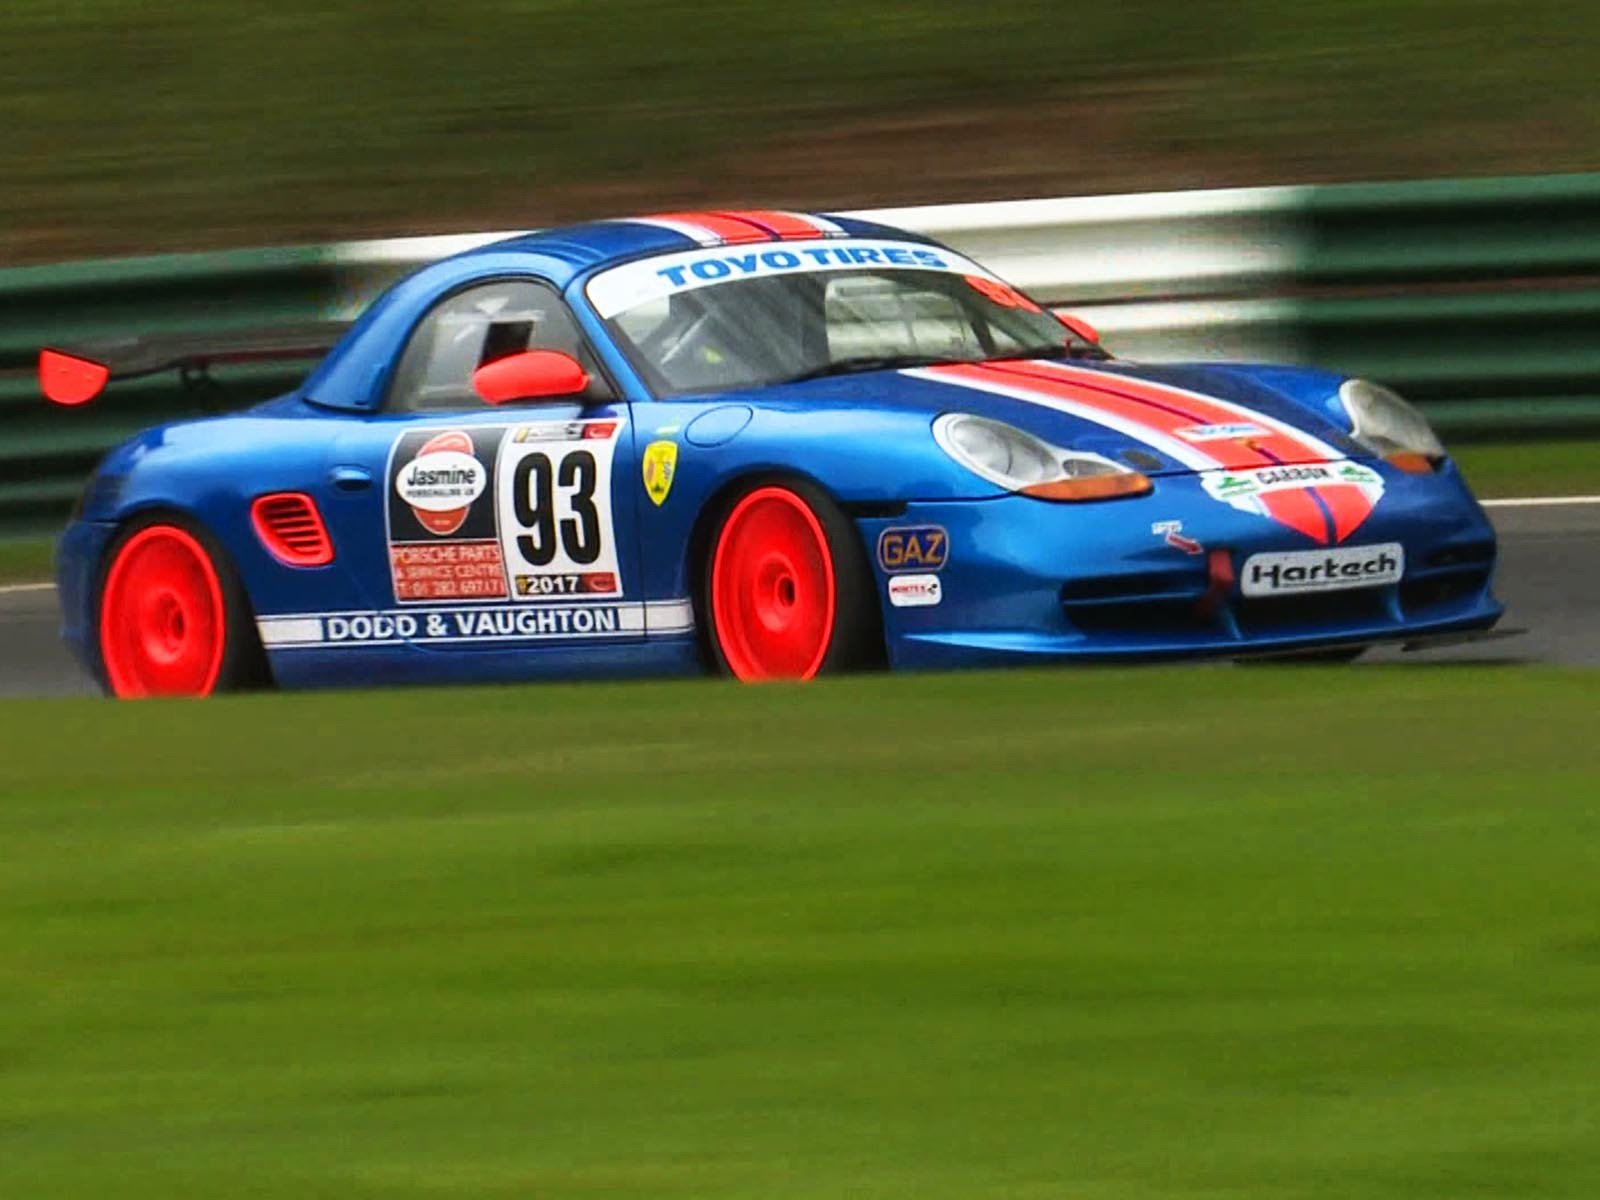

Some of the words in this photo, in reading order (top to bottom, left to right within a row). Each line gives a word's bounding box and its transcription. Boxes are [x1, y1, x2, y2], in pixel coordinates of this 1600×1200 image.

[656, 251, 801, 287] TOYO
[802, 248, 948, 267] TIRES
[407, 464, 476, 486] Jasmine
[513, 450, 601, 566] 93
[883, 533, 943, 566] GAZ
[527, 576, 578, 593] 2017
[1252, 553, 1396, 588] Hartech
[327, 615, 417, 639] DODD
[426, 614, 448, 636] &
[455, 607, 615, 635] VAUGHTON
